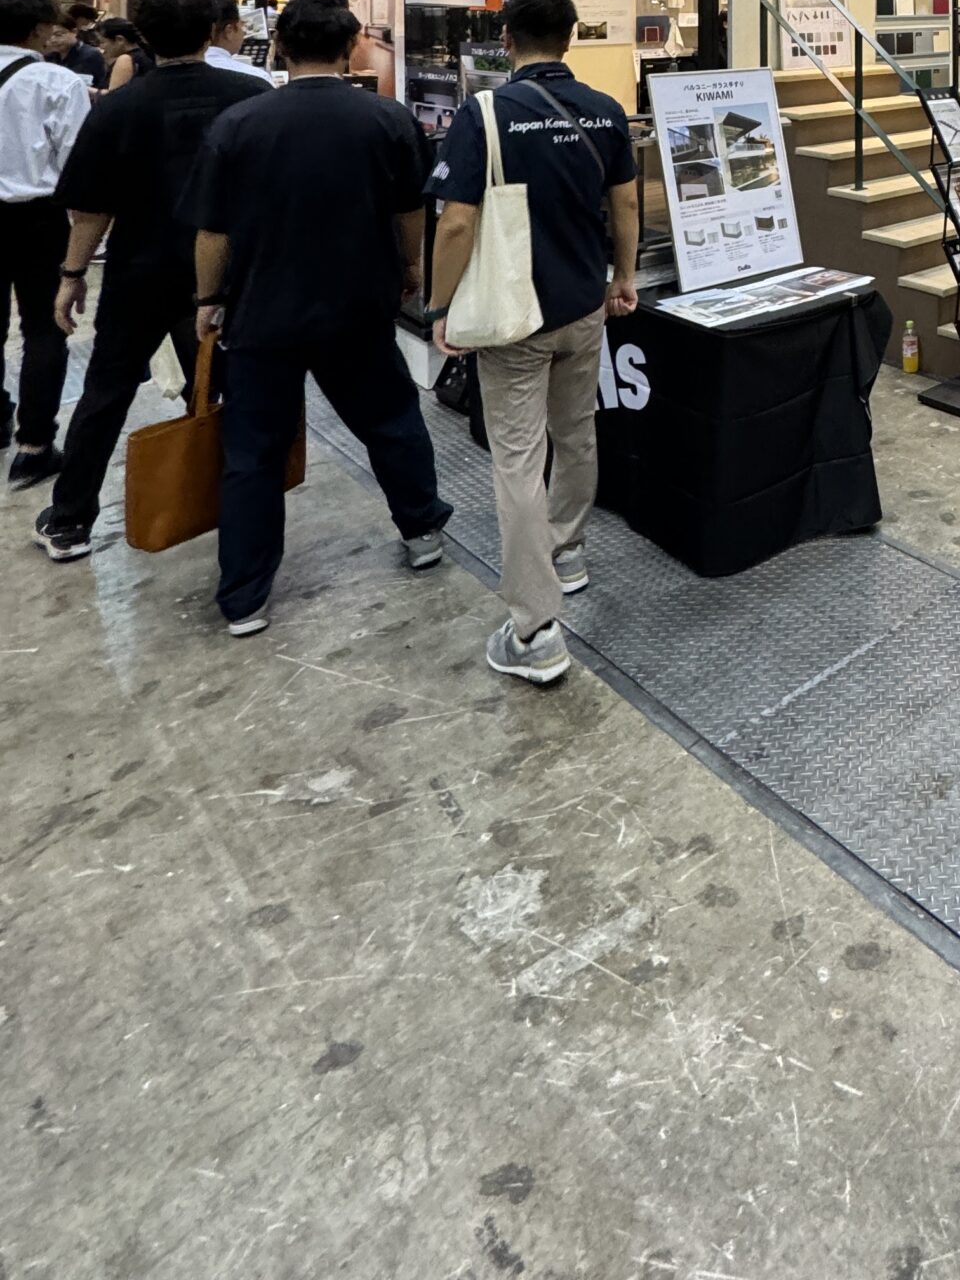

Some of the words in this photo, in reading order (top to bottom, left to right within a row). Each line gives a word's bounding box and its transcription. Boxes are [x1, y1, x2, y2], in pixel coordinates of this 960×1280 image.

[696, 90, 734, 102] KIWAMI
[508, 121, 543, 133] Japan
[553, 134, 579, 143] STAFF
